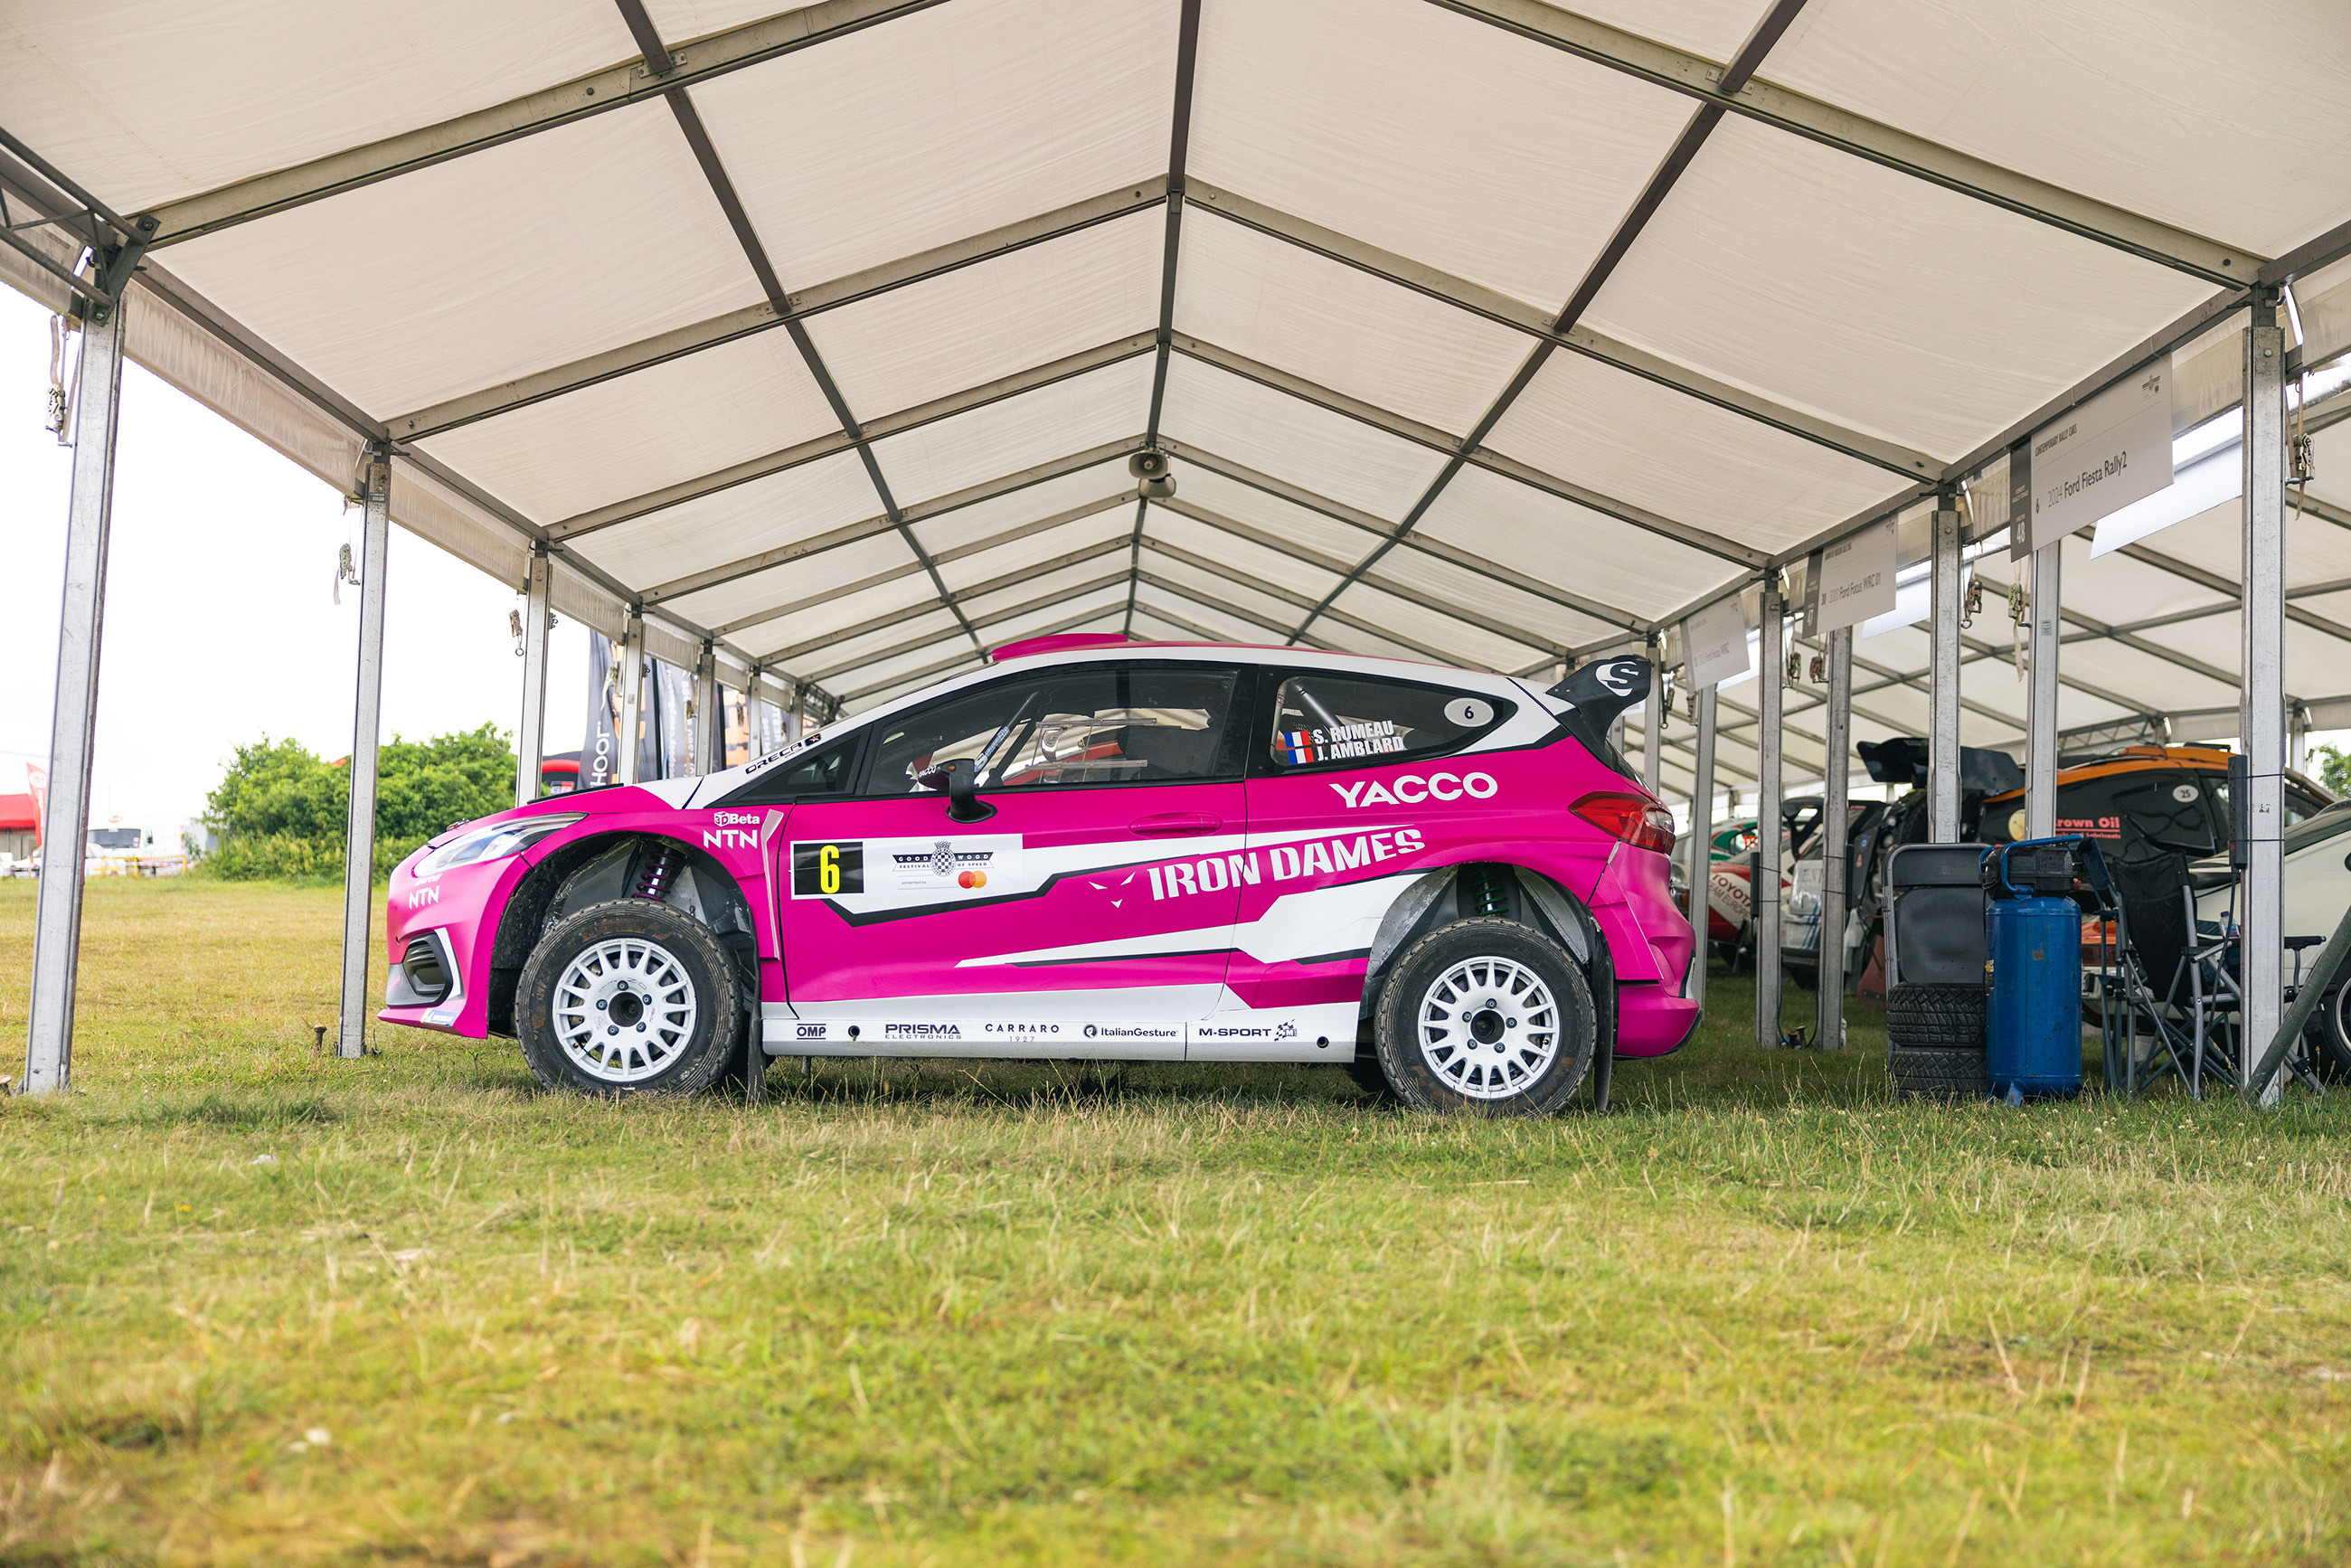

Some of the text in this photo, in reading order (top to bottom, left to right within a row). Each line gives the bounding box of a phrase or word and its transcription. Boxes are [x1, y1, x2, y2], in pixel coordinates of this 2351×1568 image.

[2047, 486, 2063, 508] 2024
[2063, 476, 2080, 498] Ford
[2082, 468, 2103, 489] Fiesta
[2104, 450, 2128, 477] Rally2
[2016, 521, 2025, 544] 48
[1464, 705, 1475, 720] 6
[1313, 720, 1394, 744] S. RUMEAU
[745, 741, 803, 775] ORECA
[1317, 736, 1404, 761] J. AMBLARD
[1328, 771, 1498, 808] YACCO
[2180, 789, 2192, 798] 25
[730, 813, 760, 825] Beta
[2055, 816, 2120, 828] rown Oil
[703, 829, 758, 849] NTN
[819, 845, 841, 894] 6
[1147, 828, 1426, 902] IRON DAMES
[408, 884, 440, 910] NTN
[797, 1025, 826, 1038] OMP
[884, 1024, 961, 1034] PRISMA
[985, 1024, 1060, 1034] CARRARO
[1100, 1027, 1176, 1037] ItalianGesture
[1198, 1027, 1272, 1037] M-SPORT
